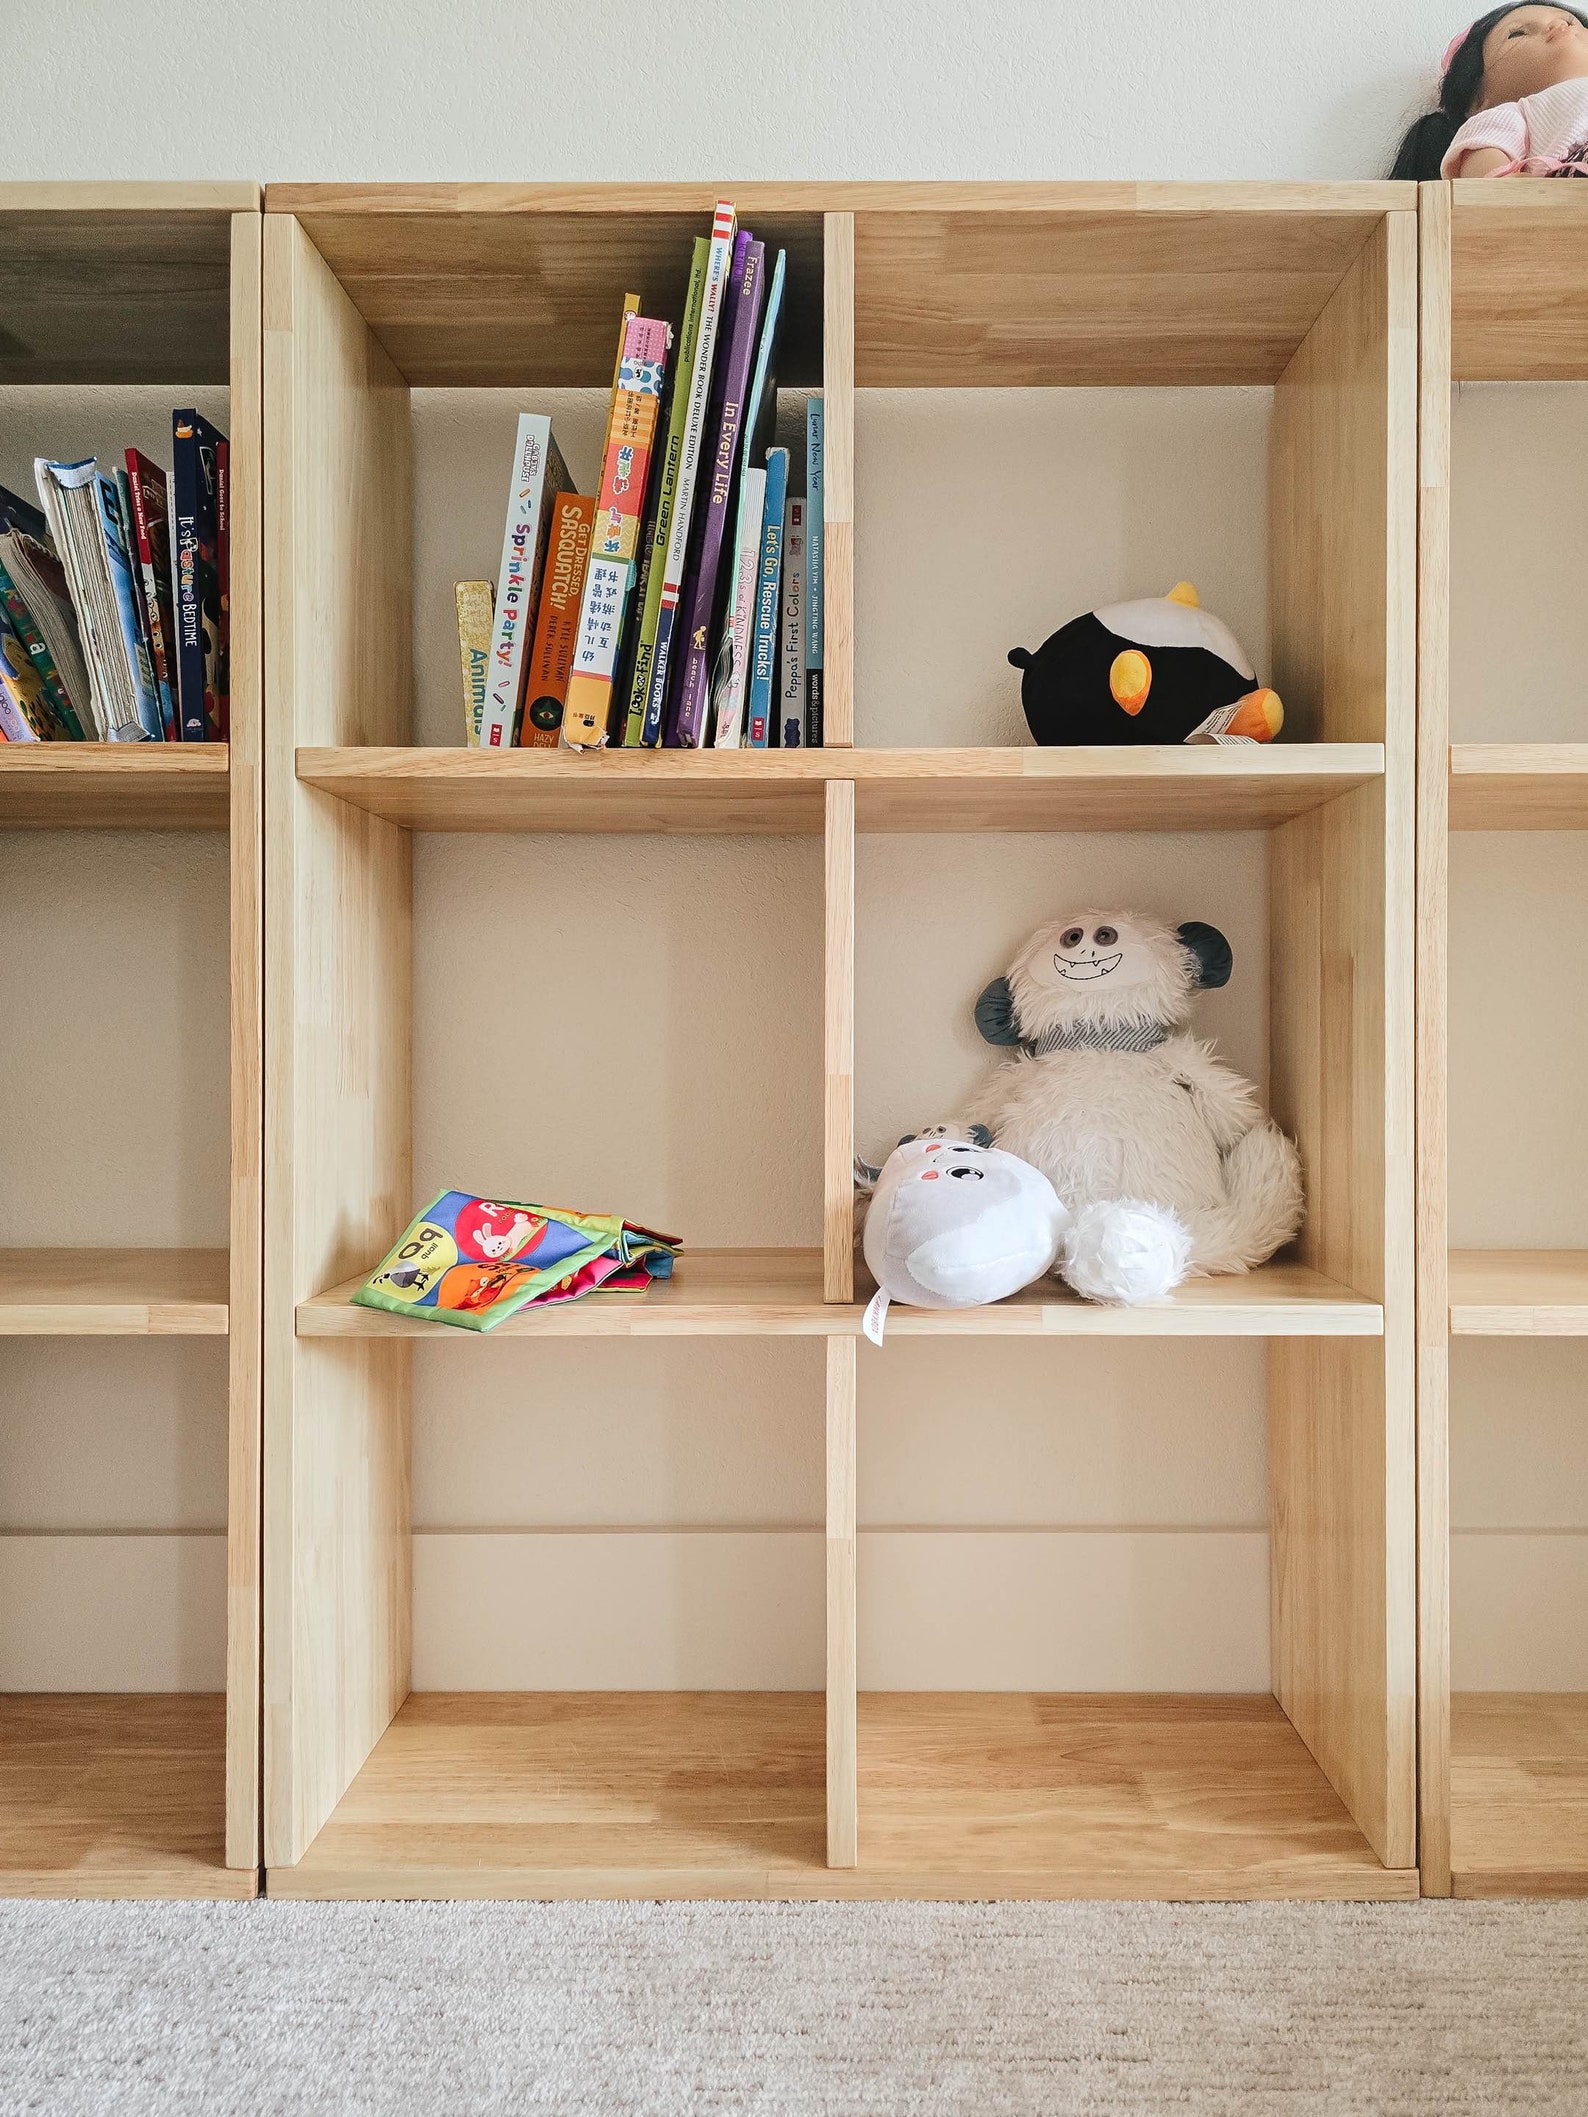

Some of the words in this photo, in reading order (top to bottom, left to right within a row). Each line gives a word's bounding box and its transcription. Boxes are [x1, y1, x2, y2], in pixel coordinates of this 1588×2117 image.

[712, 247, 722, 282] WHERE'S
[743, 256, 758, 296] Frazee
[708, 284, 717, 312] WALLY?
[705, 316, 713, 331] THE
[684, 324, 694, 362] publications
[700, 334, 710, 371] WONDER
[695, 374, 705, 399] BOOK
[690, 402, 701, 433] DELUXE
[724, 401, 739, 417] In
[810, 413, 820, 440] Lunar
[521, 434, 535, 482] DOLLHOUSE
[685, 435, 696, 470] EDITION
[717, 421, 736, 469] Every
[811, 443, 821, 466] New
[131, 471, 139, 491] Daniel
[656, 500, 670, 546] Green
[663, 435, 680, 498] Lantern
[680, 478, 690, 513] MARTIN
[712, 473, 729, 505] Life
[810, 470, 821, 491] Year
[178, 515, 194, 538] It's
[578, 523, 590, 545] GET
[673, 514, 686, 561] HANDFORD
[766, 525, 780, 554] Let's
[507, 524, 530, 603] Sprinkle
[550, 504, 582, 611] SASQUATCH!
[568, 547, 587, 596] DRESSED,
[763, 557, 778, 577] Go,
[598, 571, 619, 649] 互动游戏书
[760, 581, 777, 630] Rescue
[786, 572, 800, 617] Colors
[182, 604, 198, 648] BEDTIME
[547, 615, 558, 640] DEREK
[560, 621, 572, 641] KYLE
[582, 568, 607, 662] 幼儿情绪管理
[496, 609, 518, 668] Party!
[786, 622, 798, 652] First
[541, 642, 553, 681] SULLIVAN
[555, 645, 568, 682] SULLIVAN
[656, 640, 668, 679] WALKER
[756, 633, 774, 681] Trucks!
[652, 679, 664, 708] BOOKS
[785, 657, 801, 698] Peppa's
[534, 732, 554, 741] HAZY
[421, 1243, 438, 1260] quail
